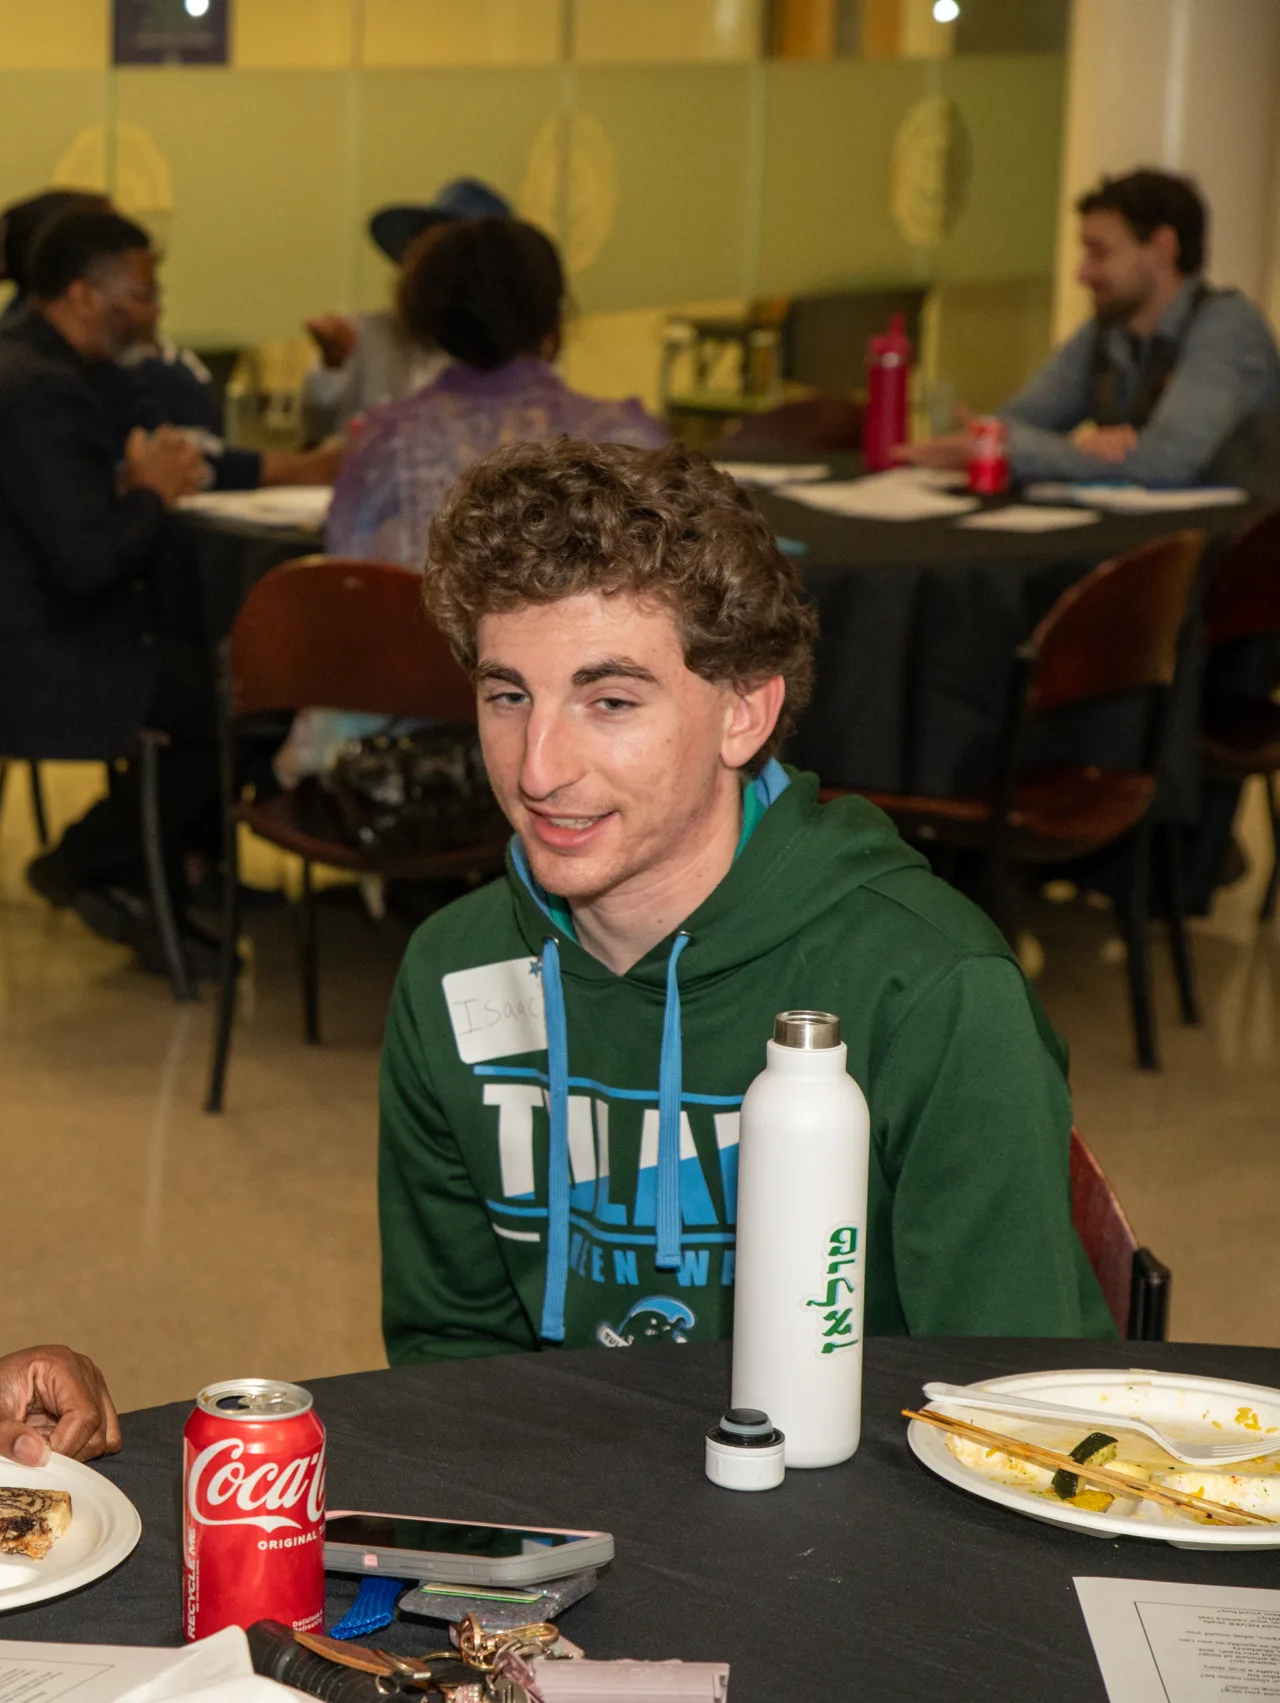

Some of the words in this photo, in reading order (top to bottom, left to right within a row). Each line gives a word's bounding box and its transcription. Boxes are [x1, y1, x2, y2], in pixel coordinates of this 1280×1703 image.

[452, 998, 539, 1035] Isaac
[187, 1528, 196, 1555] ME
[257, 1531, 317, 1550] ORIGINAL
[187, 1556, 196, 1639] RECYCLE
